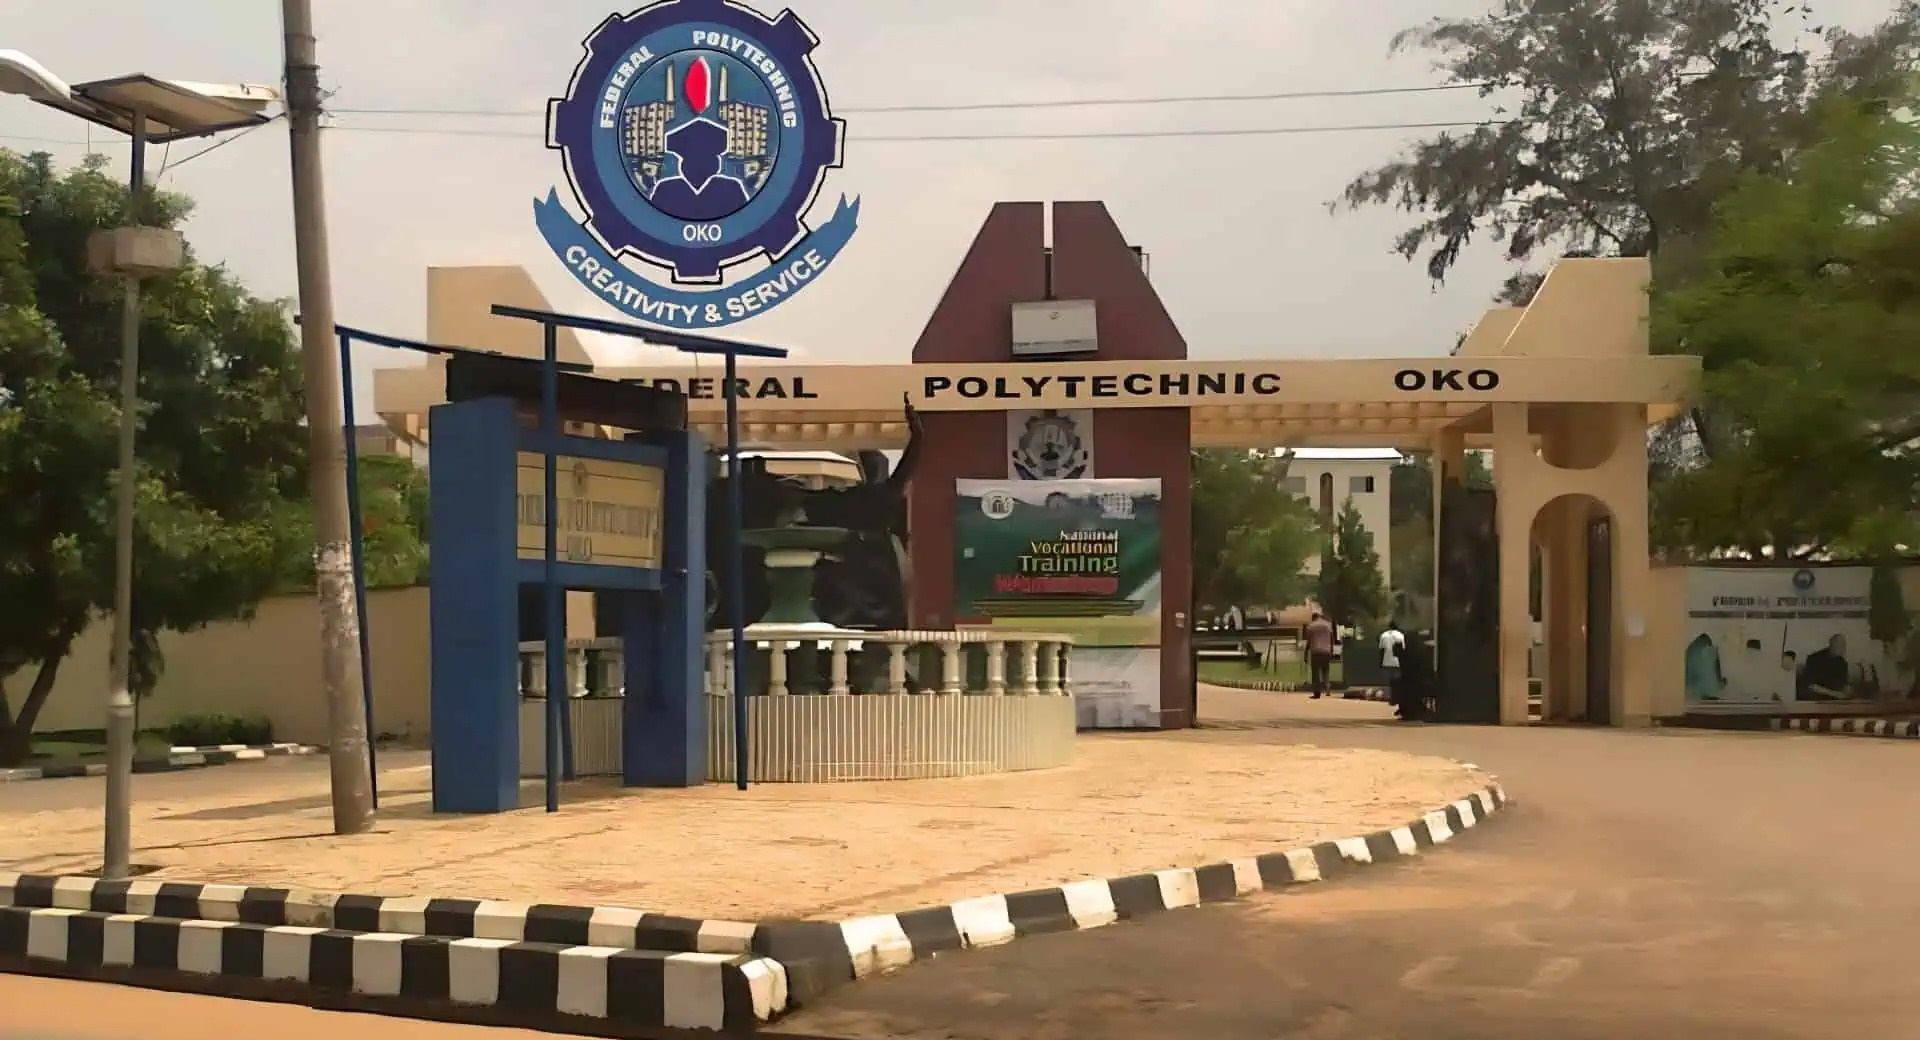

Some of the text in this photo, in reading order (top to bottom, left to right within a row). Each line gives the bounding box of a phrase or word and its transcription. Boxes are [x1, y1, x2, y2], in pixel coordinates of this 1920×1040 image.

[619, 369, 1500, 399] DERAL POLYTECHNIC OKO
[1018, 555, 1119, 574] Training
